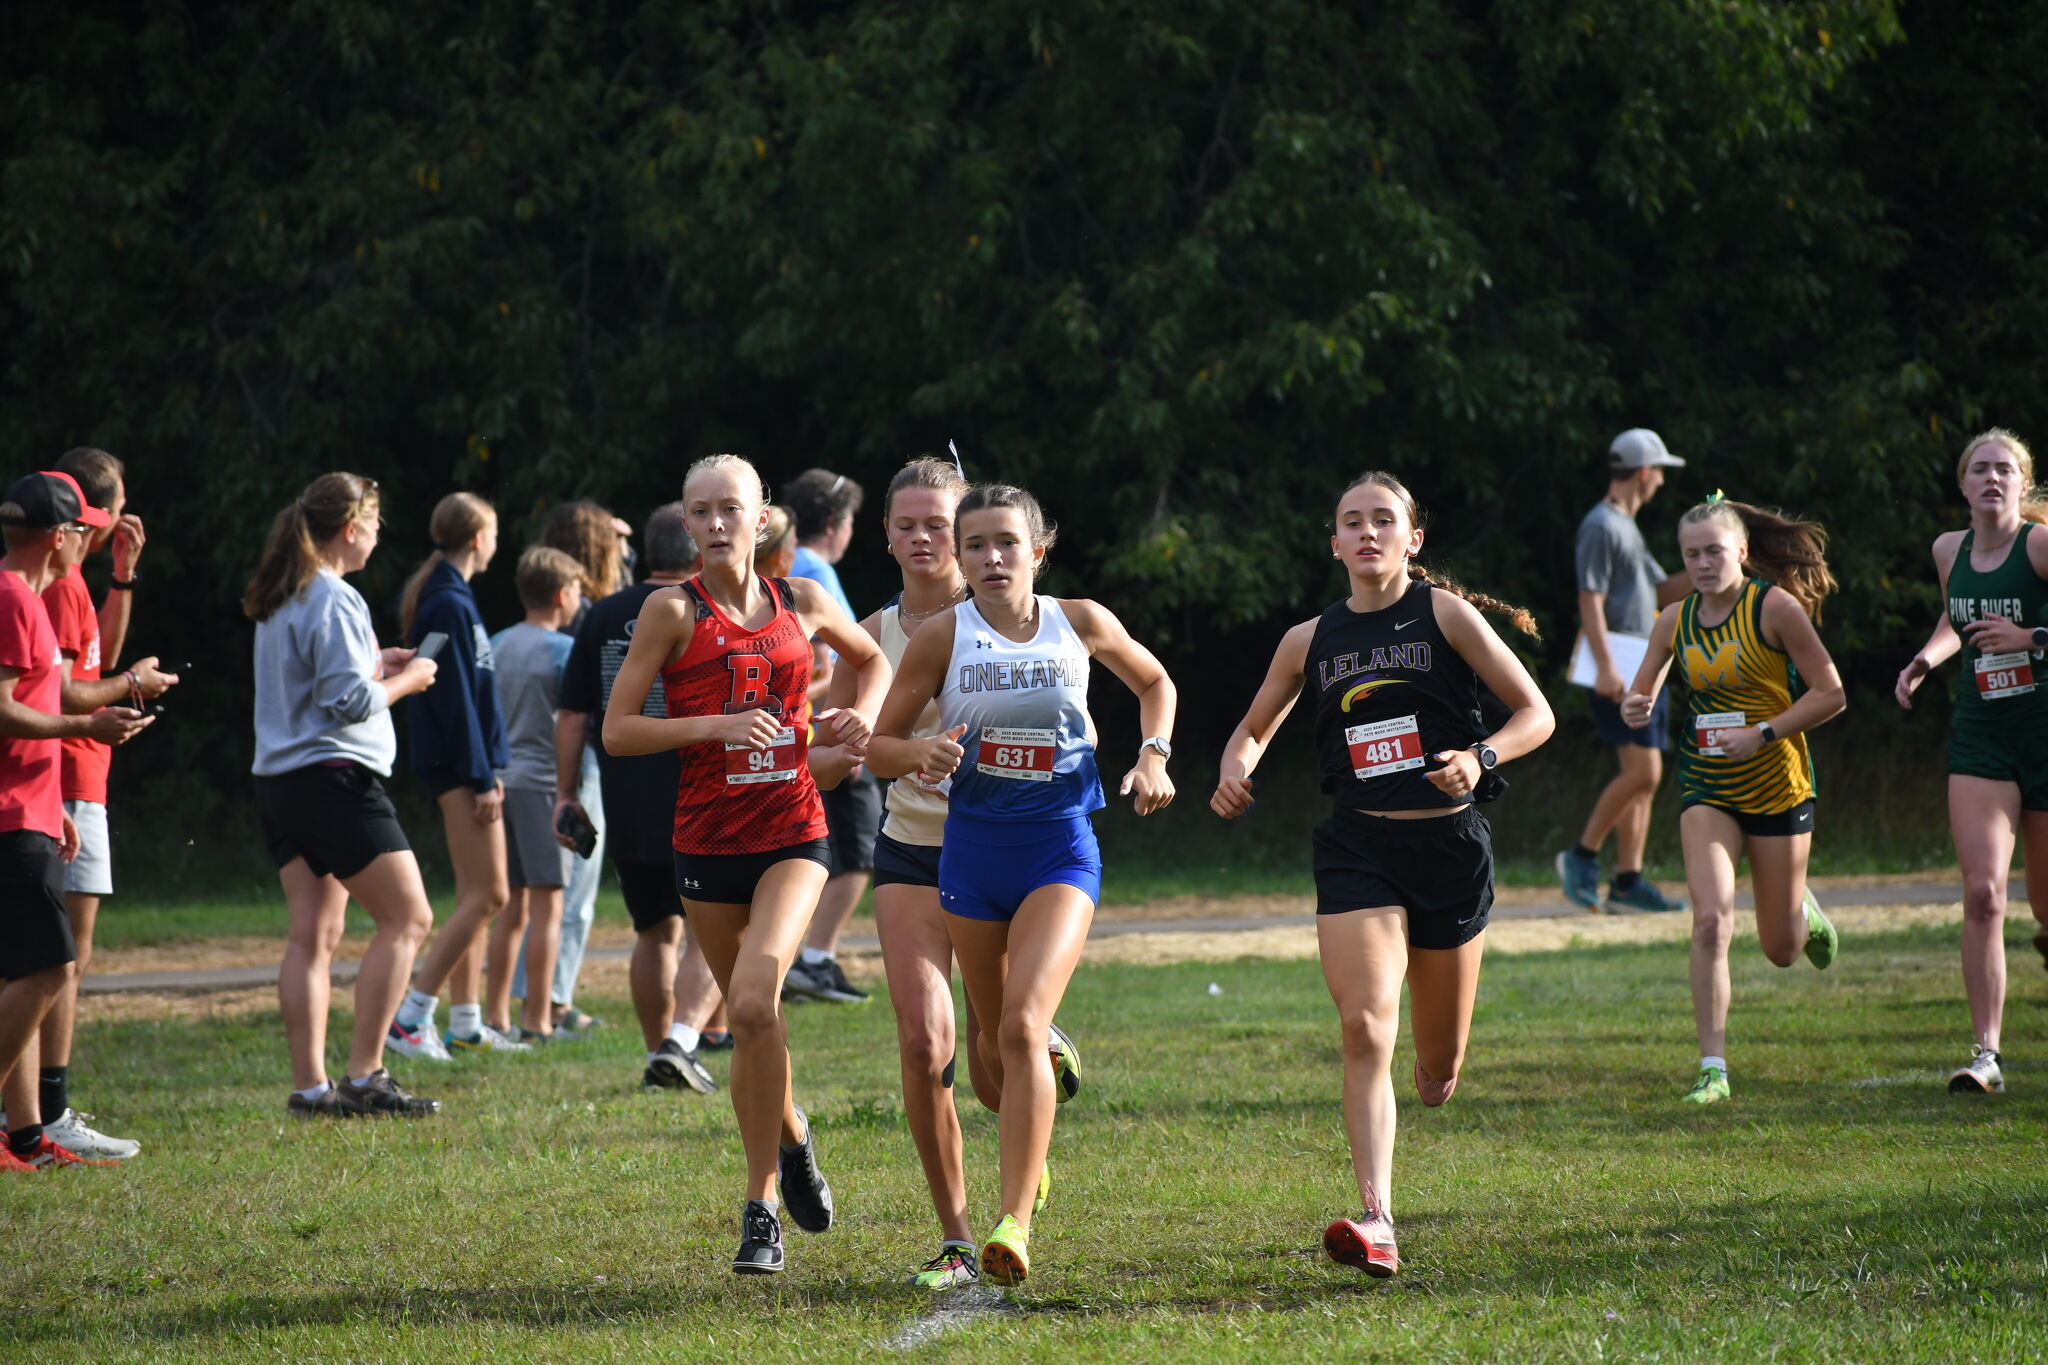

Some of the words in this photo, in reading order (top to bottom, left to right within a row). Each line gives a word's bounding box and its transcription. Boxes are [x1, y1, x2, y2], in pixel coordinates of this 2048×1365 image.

[1949, 597, 1976, 623] PINE
[1980, 598, 2023, 622] RIVER
[960, 659, 1082, 693] ONEKAMA
[1319, 641, 1432, 692] LELAND
[1682, 638, 1744, 689] M
[1987, 669, 2018, 689] 501
[1386, 724, 1413, 733] INVITATIONAL
[748, 750, 776, 771] 94
[995, 747, 1036, 768] 631
[1365, 738, 1404, 763] 481
